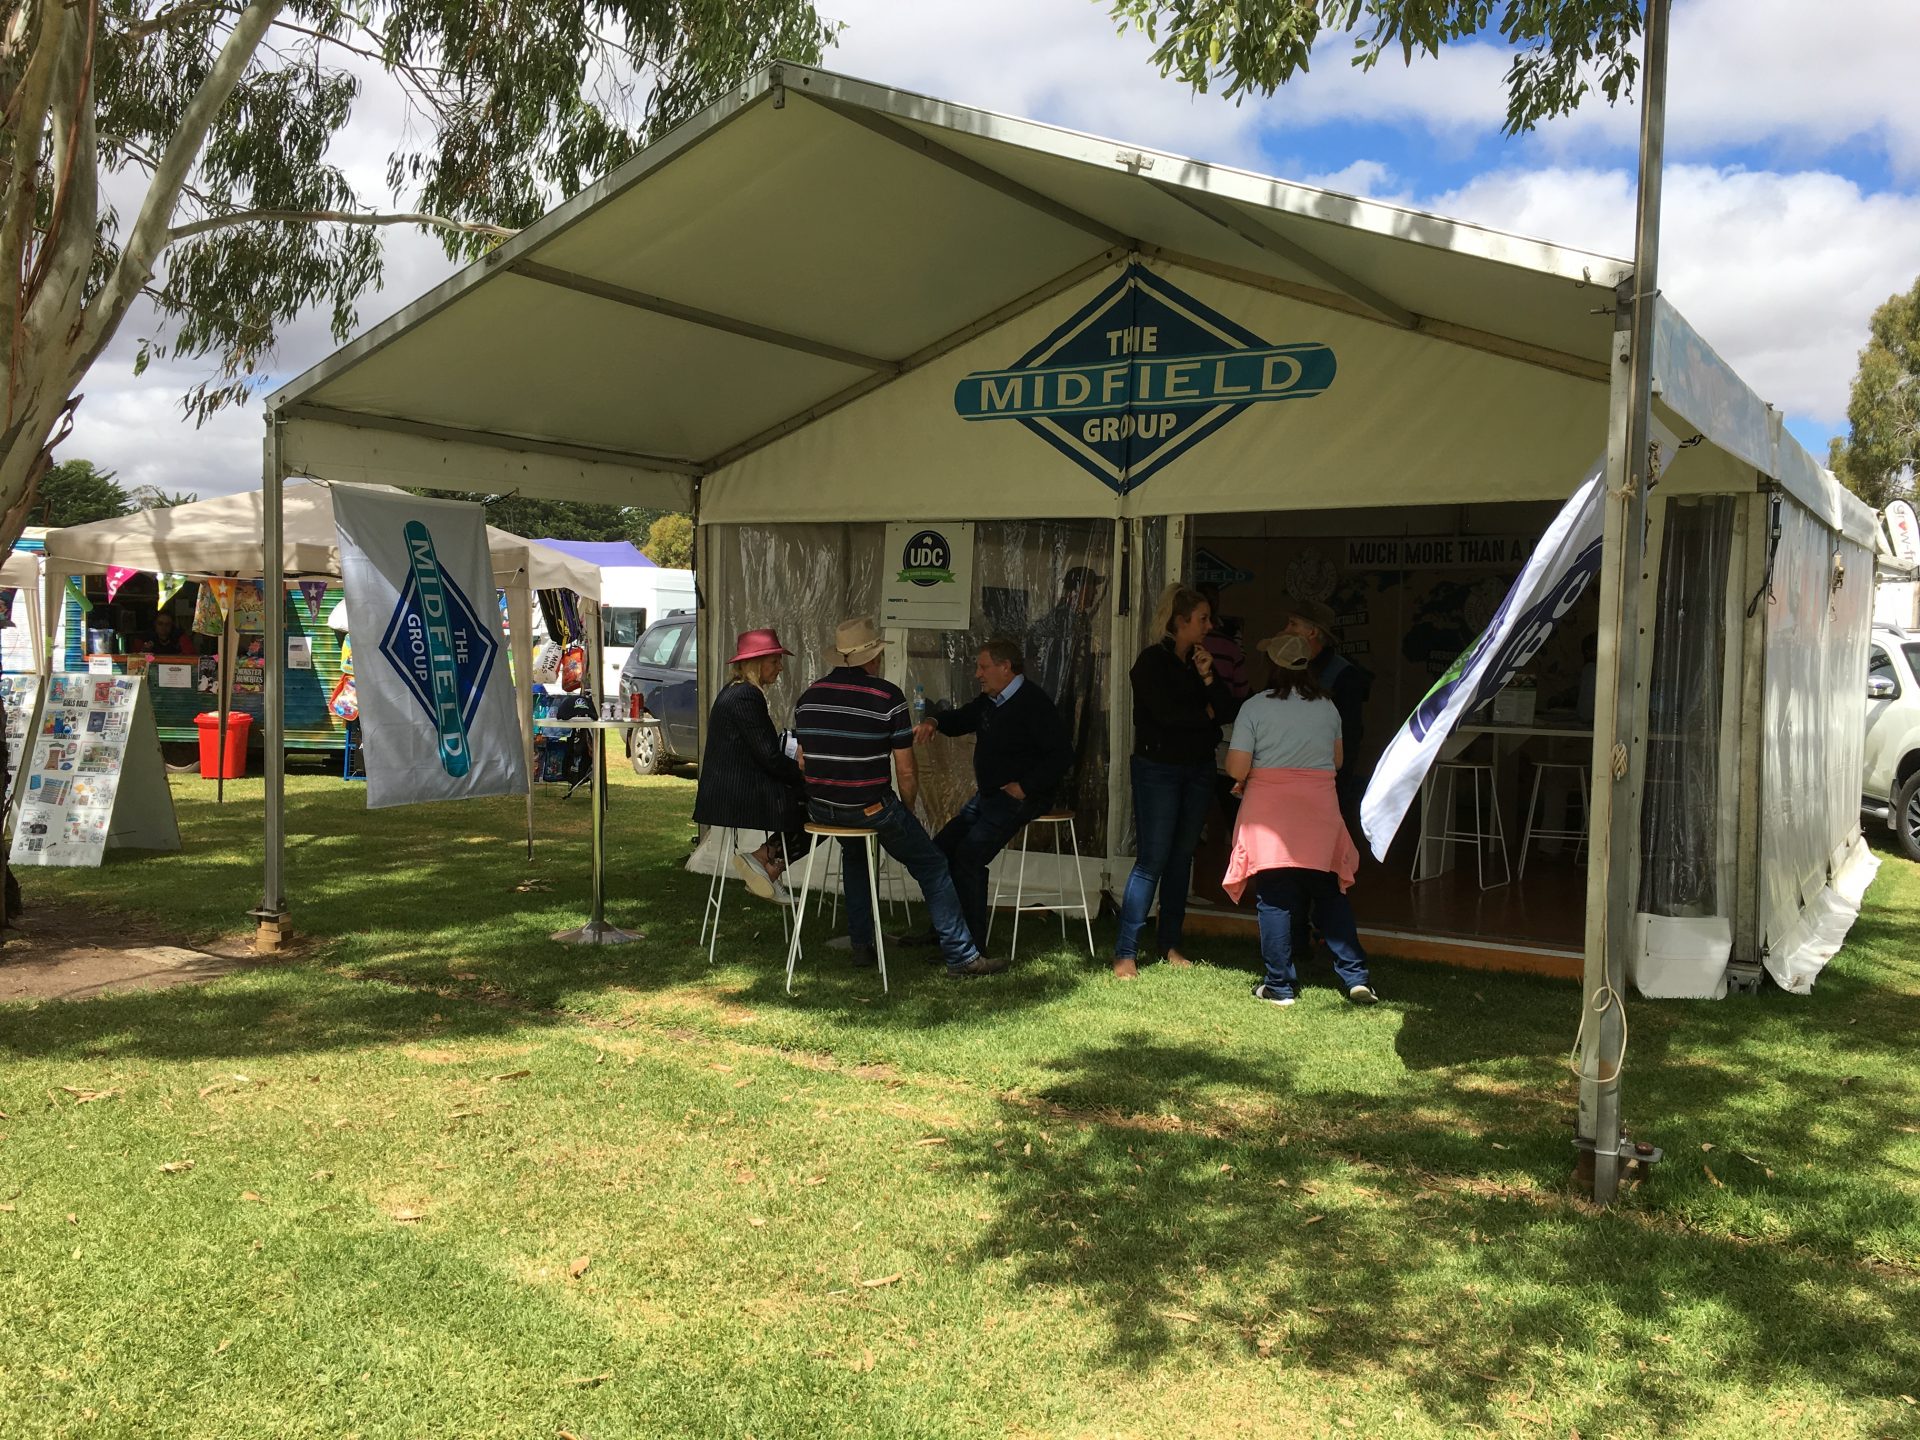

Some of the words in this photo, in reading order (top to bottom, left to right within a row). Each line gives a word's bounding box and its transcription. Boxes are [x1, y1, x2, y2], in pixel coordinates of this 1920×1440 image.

[1106, 326, 1158, 357] THE
[979, 356, 1303, 411] MIDFIELD
[1083, 413, 1177, 443] GROUP
[910, 547, 943, 567] UDC
[1349, 542, 1398, 564] MUCH
[1404, 541, 1453, 563] MORE
[1459, 539, 1505, 562] THAN
[1510, 539, 1524, 562] A
[108, 580, 118, 595] S
[407, 613, 428, 681] GROUP
[411, 539, 463, 757] MIDFIELD
[454, 628, 469, 664] THE
[541, 655, 549, 674] MISS
[548, 654, 559, 672] MEN
